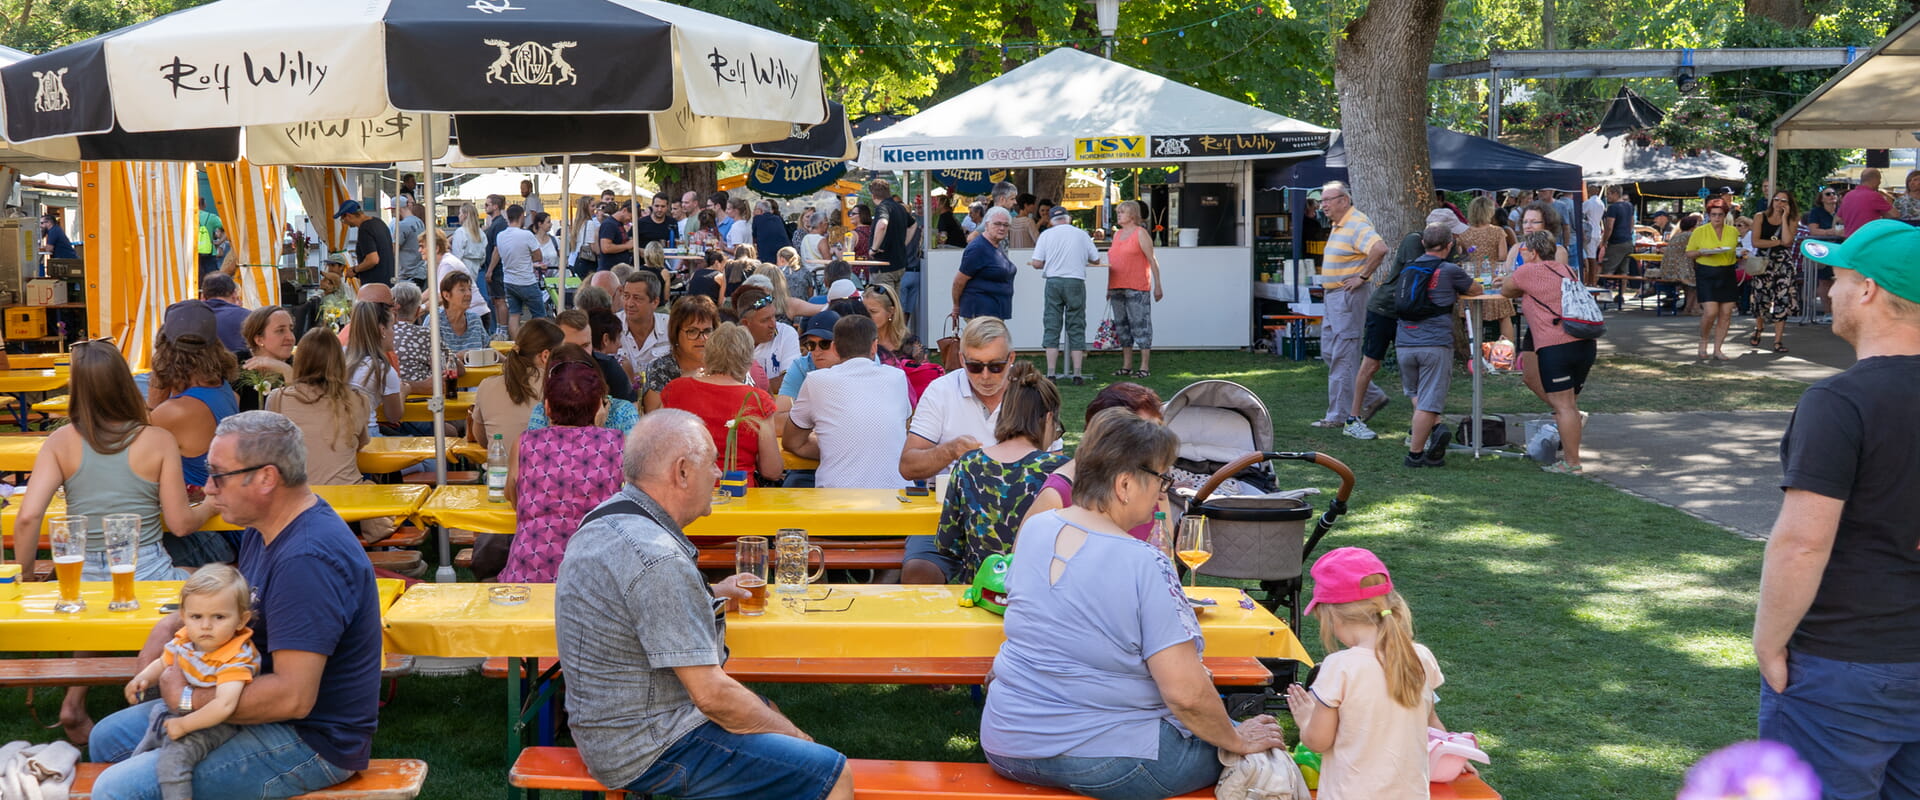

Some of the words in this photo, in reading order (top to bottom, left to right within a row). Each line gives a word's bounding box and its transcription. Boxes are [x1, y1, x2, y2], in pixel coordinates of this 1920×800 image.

[159, 55, 231, 105] Rolf
[243, 50, 328, 97] Willy
[707, 46, 748, 98] Rolf
[750, 51, 799, 100] Willy
[883, 147, 984, 163] Kleemann
[986, 146, 1066, 162] Getränke
[1078, 137, 1142, 153] TSV
[1198, 134, 1231, 155] Rolf
[1236, 134, 1277, 154] Willy
